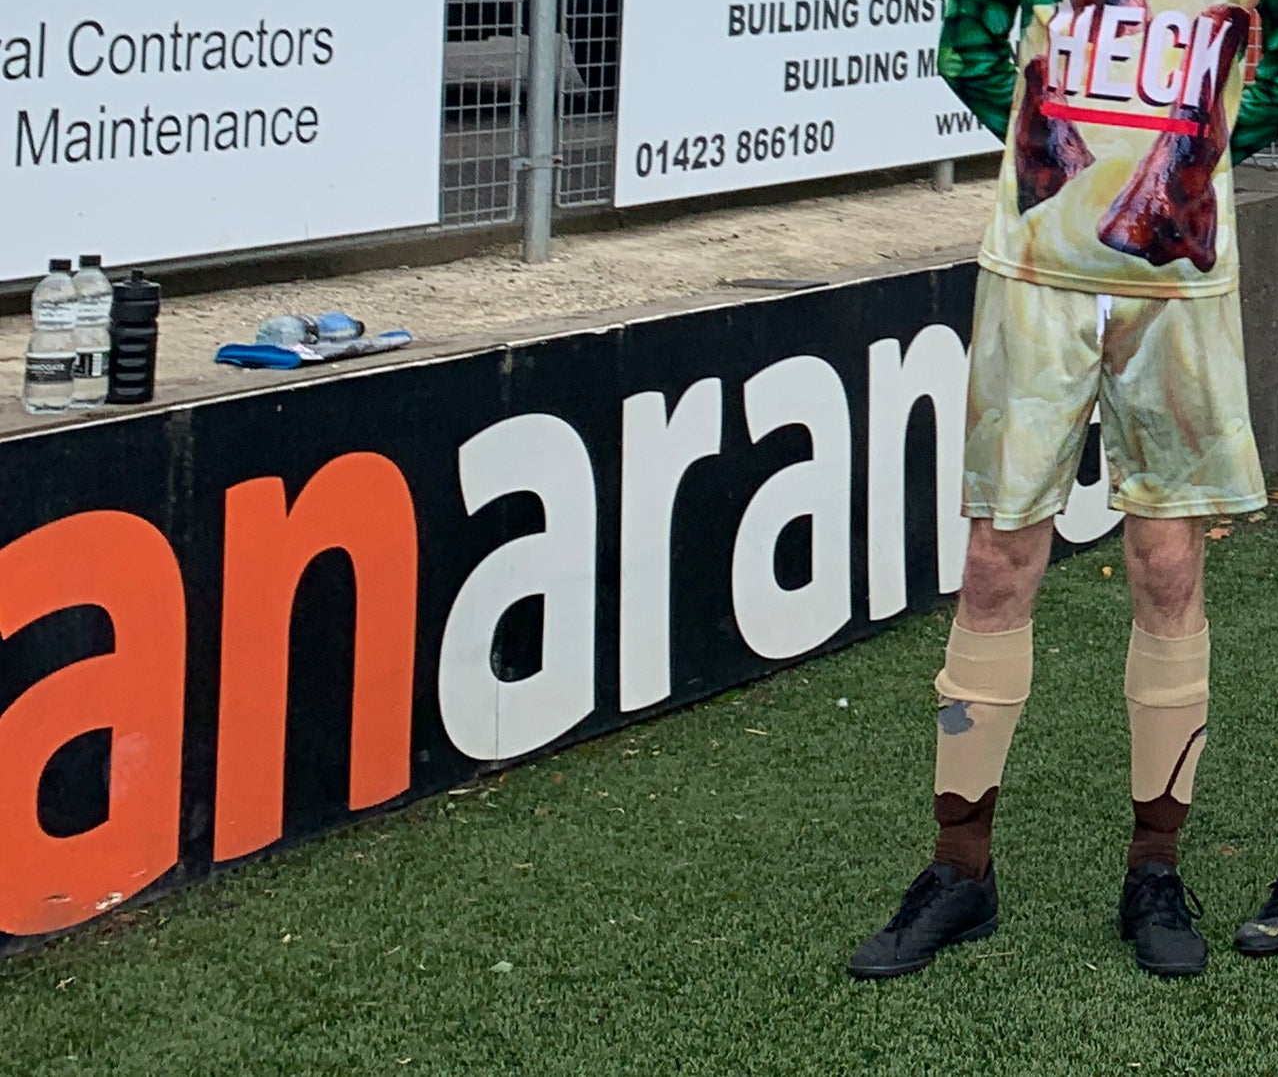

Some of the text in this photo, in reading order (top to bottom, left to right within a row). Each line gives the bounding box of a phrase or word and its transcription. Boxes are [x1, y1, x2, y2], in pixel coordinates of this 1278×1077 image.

[728, 0, 858, 36] BUILDING
[0, 20, 334, 80] al Contractors
[784, 56, 908, 93] BUILDING
[1043, 1, 1235, 108] HECK
[15, 105, 319, 168] Maintenance
[635, 120, 835, 178] 01423 866180
